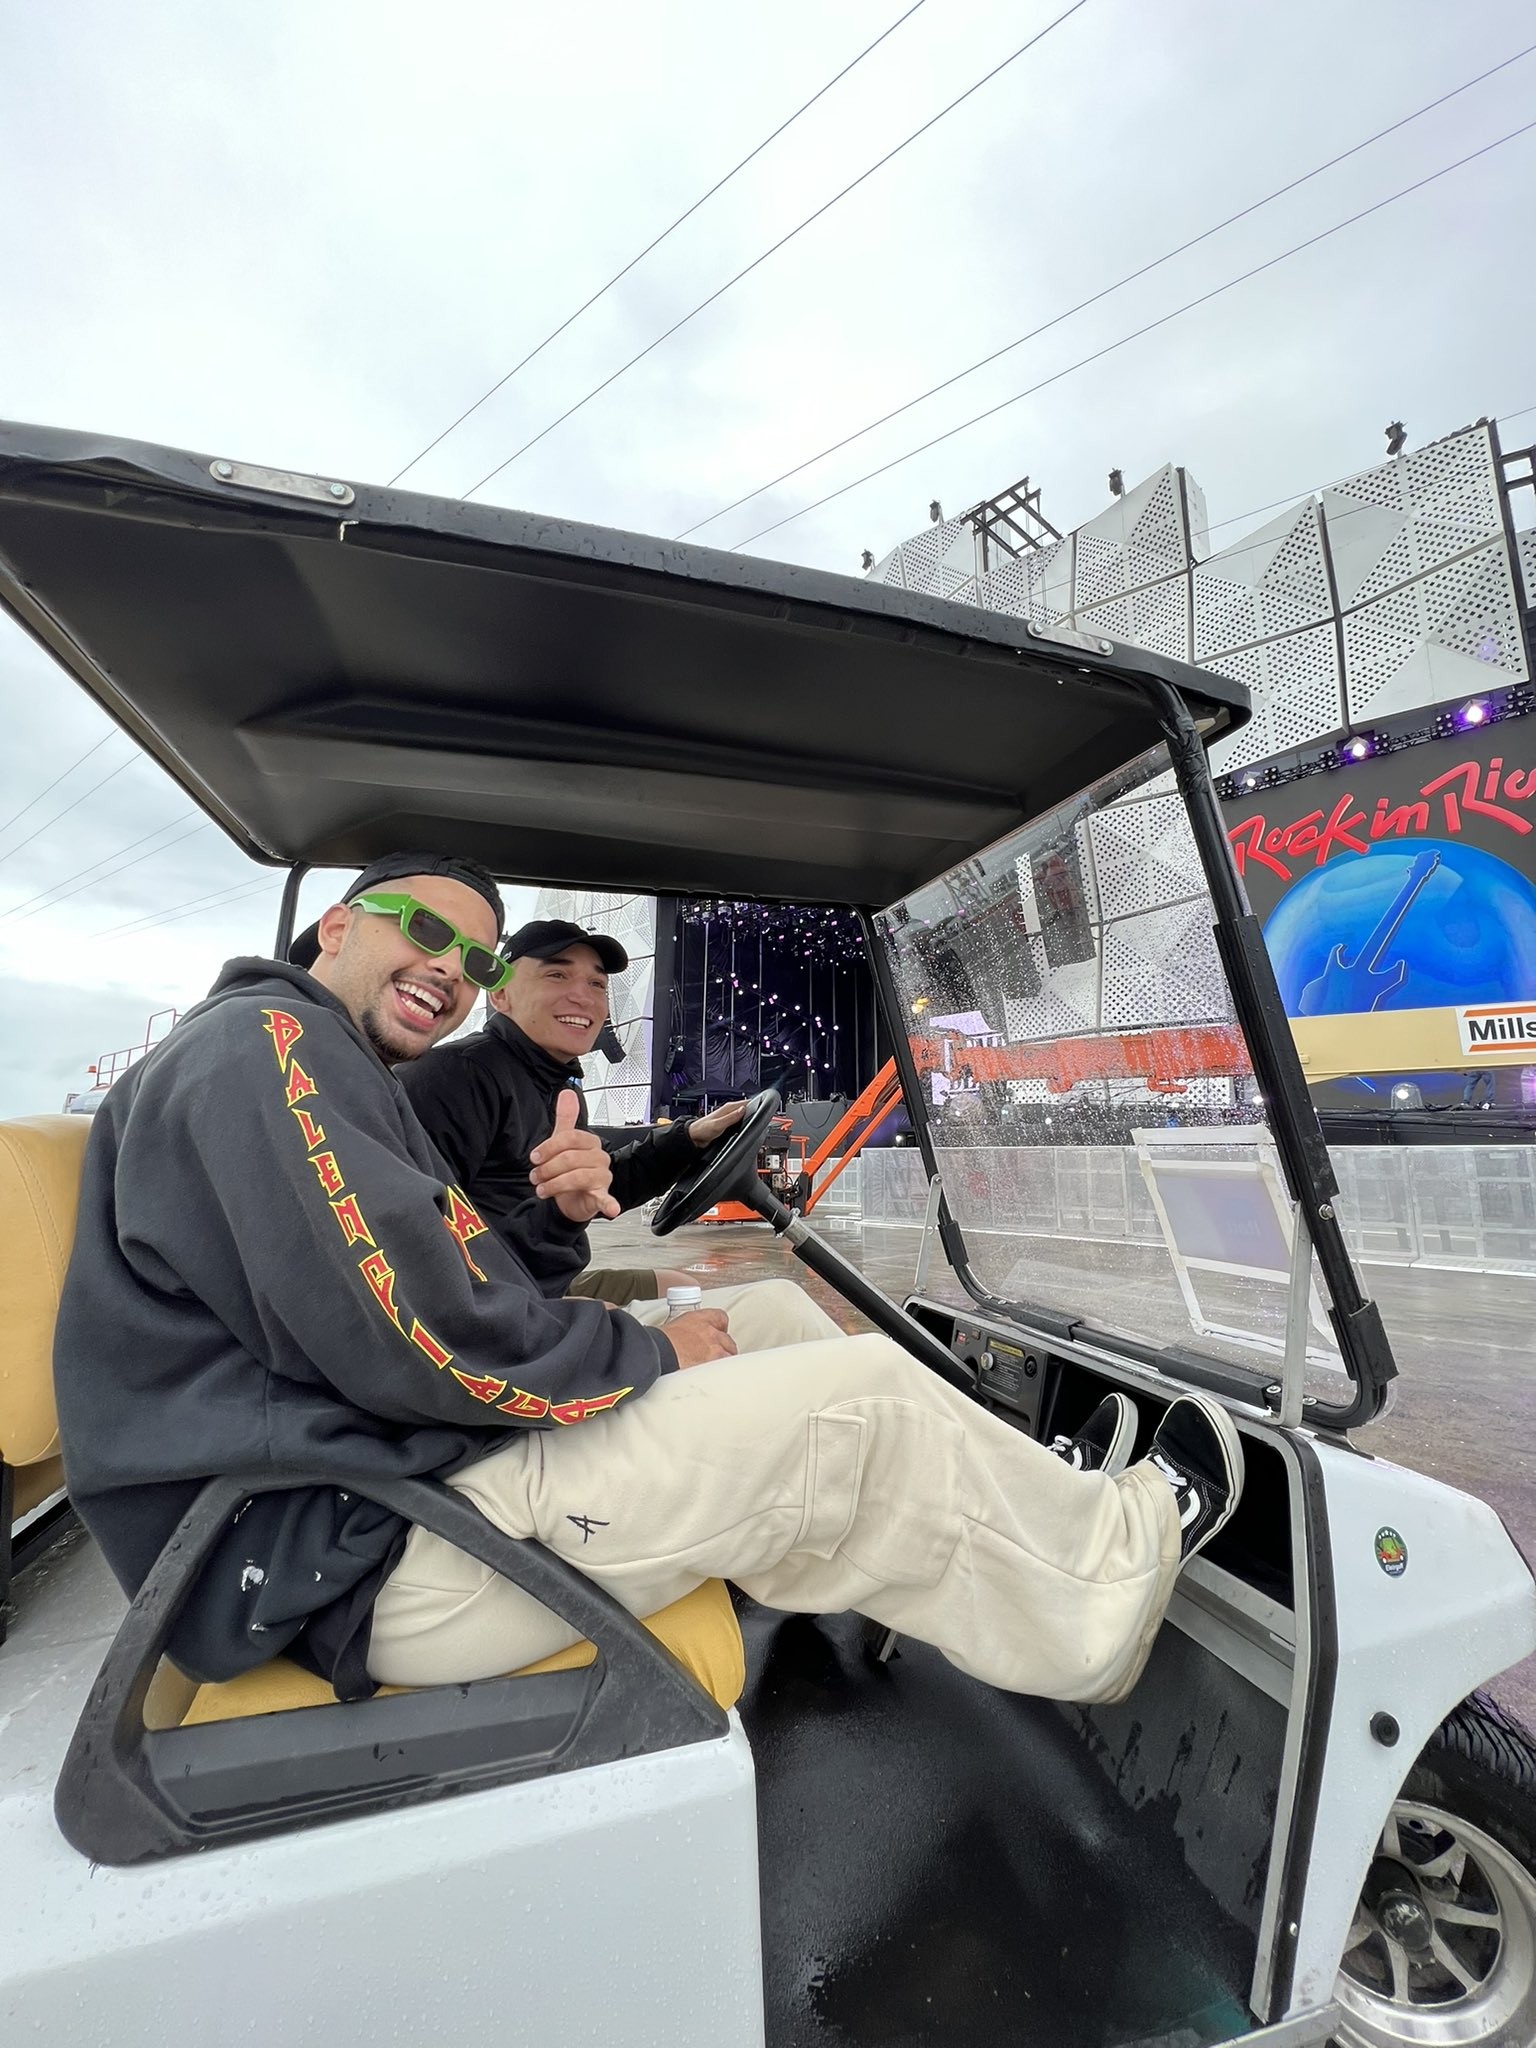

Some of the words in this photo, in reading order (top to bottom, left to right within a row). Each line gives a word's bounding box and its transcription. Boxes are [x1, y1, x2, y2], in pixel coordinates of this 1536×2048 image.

[1228, 793, 1370, 881] Rock
[1369, 797, 1430, 839] in
[1468, 1017, 1536, 1041] Mills
